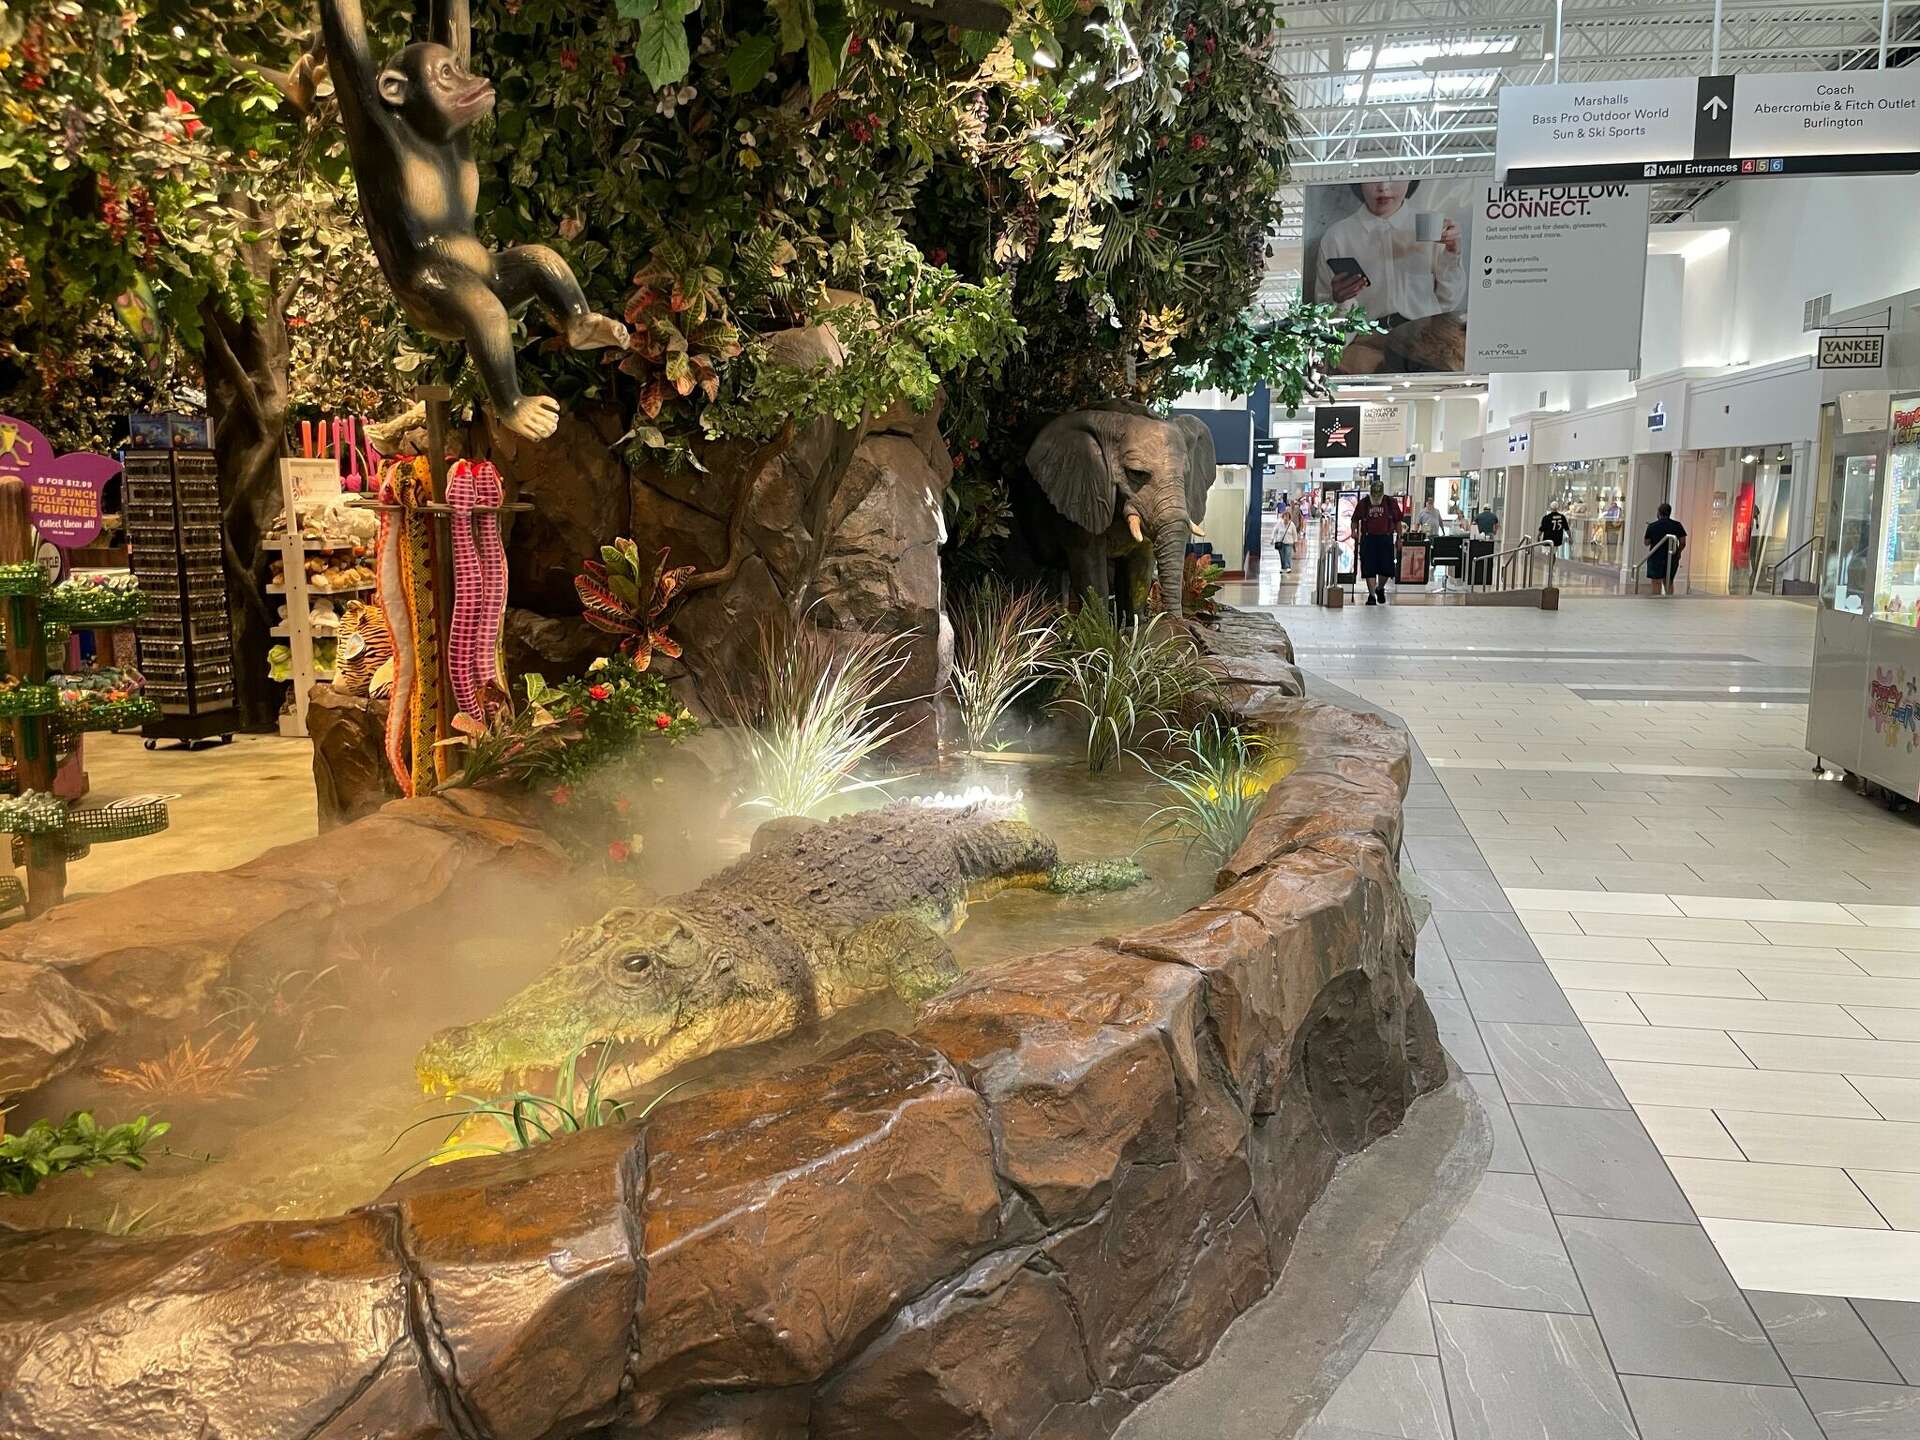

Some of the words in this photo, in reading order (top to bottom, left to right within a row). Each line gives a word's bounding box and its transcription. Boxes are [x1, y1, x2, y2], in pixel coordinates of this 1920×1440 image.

[1817, 84, 1854, 96] Coach
[1573, 94, 1629, 107] Marshalls
[1754, 100, 1831, 114] Abercrombie
[1834, 101, 1842, 111] &
[1845, 99, 1874, 111] Fitch
[1878, 98, 1916, 110] Outlet
[1532, 114, 1557, 125] Bass
[1560, 112, 1580, 124] Pro
[1582, 110, 1631, 122] Outdoor
[1634, 108, 1669, 119] World
[1803, 117, 1863, 130] Burlington
[1552, 129, 1574, 140] Sun
[1577, 128, 1586, 139] &
[1588, 127, 1606, 138] Ski
[1608, 125, 1646, 139] Sports
[1658, 164, 1682, 175] Mall
[1685, 162, 1738, 174] Entrances
[1744, 161, 1753, 171] 4
[1758, 160, 1767, 171] 5
[1772, 159, 1781, 170] 6
[1487, 187, 1533, 203] LIKE.
[1540, 184, 1629, 200] FOLLOW.
[1486, 200, 1591, 219] CONNECT.
[1825, 340, 1879, 352] YANKEE
[1823, 352, 1878, 364] CANDLE
[46, 478, 64, 486] FOR
[31, 486, 57, 495] WILD
[60, 489, 97, 499] BUNCH
[31, 495, 97, 507] COLLECTIBLE
[31, 504, 97, 518] FIGURINES
[39, 520, 61, 528] Collect
[63, 520, 82, 528] them
[1552, 519, 1562, 531] 75
